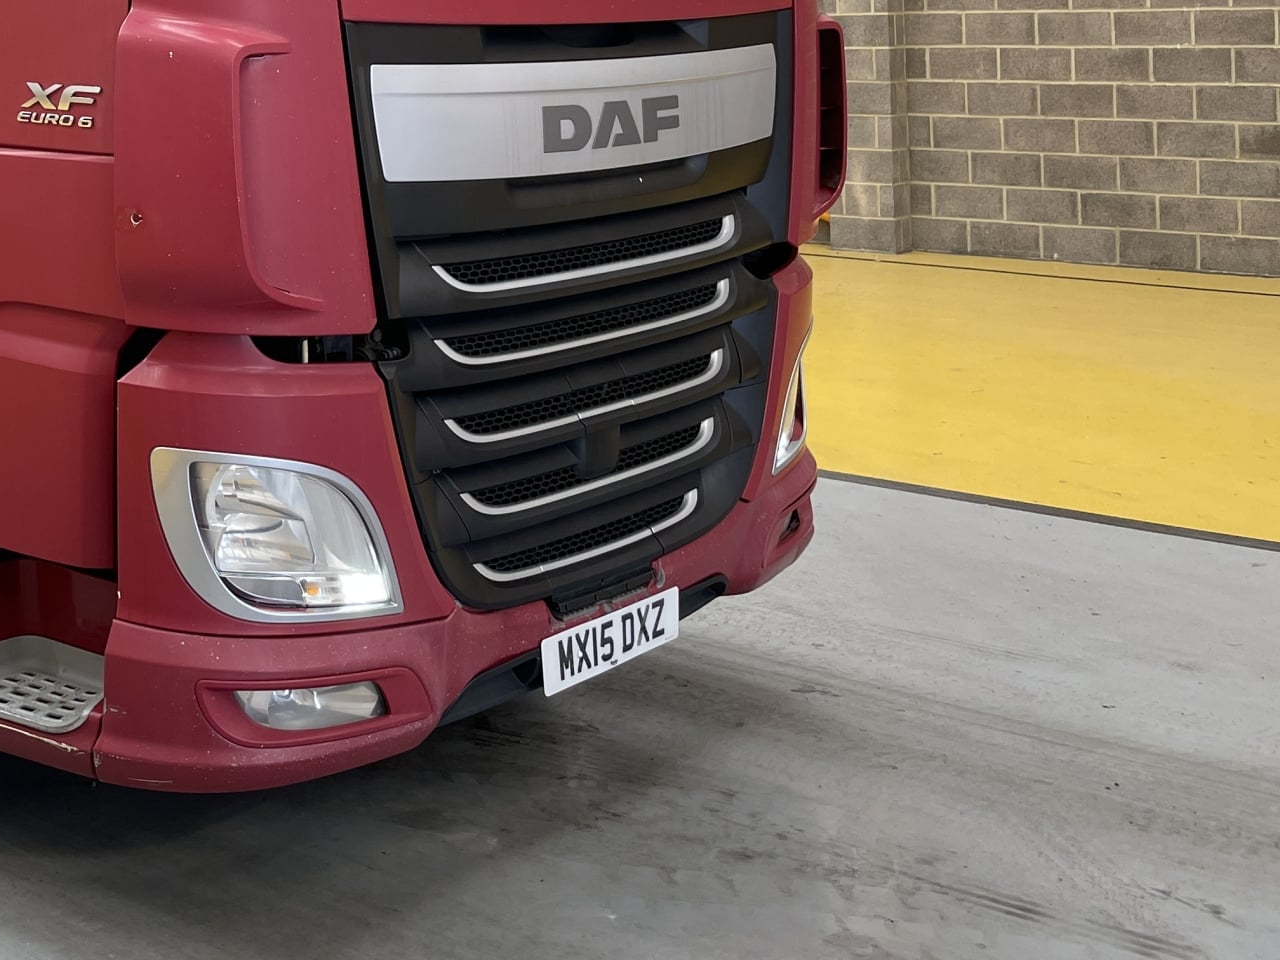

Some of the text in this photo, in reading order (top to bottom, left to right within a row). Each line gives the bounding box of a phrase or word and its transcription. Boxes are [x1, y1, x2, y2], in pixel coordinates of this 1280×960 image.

[20, 81, 102, 111] XF
[16, 110, 94, 128] EURO 6
[541, 94, 681, 154] DAF
[557, 597, 666, 682] MX15 DXZ
